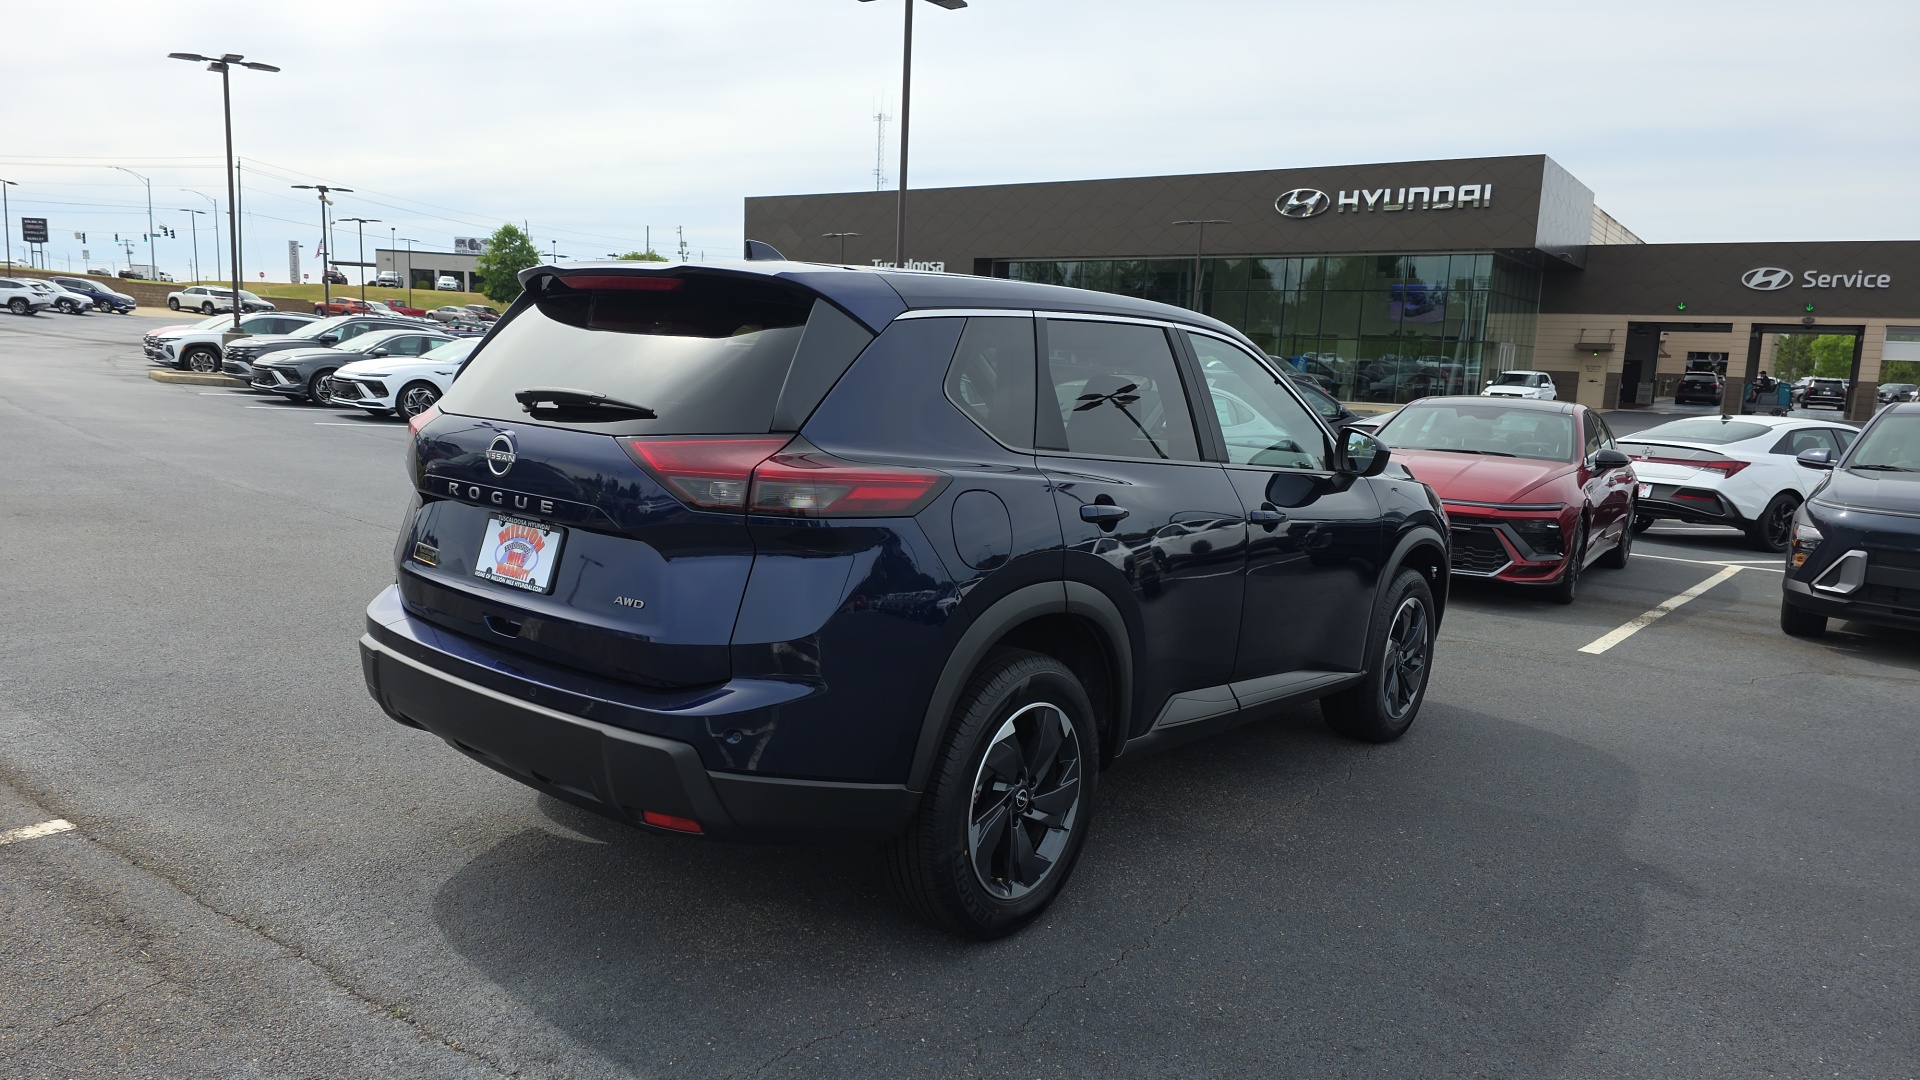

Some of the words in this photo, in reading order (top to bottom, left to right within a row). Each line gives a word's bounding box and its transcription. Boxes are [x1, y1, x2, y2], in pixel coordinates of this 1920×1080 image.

[1338, 183, 1492, 213] HYUNDAI
[1801, 269, 1891, 288] Service
[486, 451, 516, 463] NISSAN
[448, 481, 554, 514] ROGUE
[498, 515, 528, 527] TUSCALOOSA
[527, 521, 551, 530] HYUNDAI
[498, 524, 546, 553] MILLION
[507, 551, 526, 567] MILE
[496, 564, 530, 581] WARRANTY
[614, 596, 645, 609] AWD
[952, 849, 992, 927] VELOCITY
